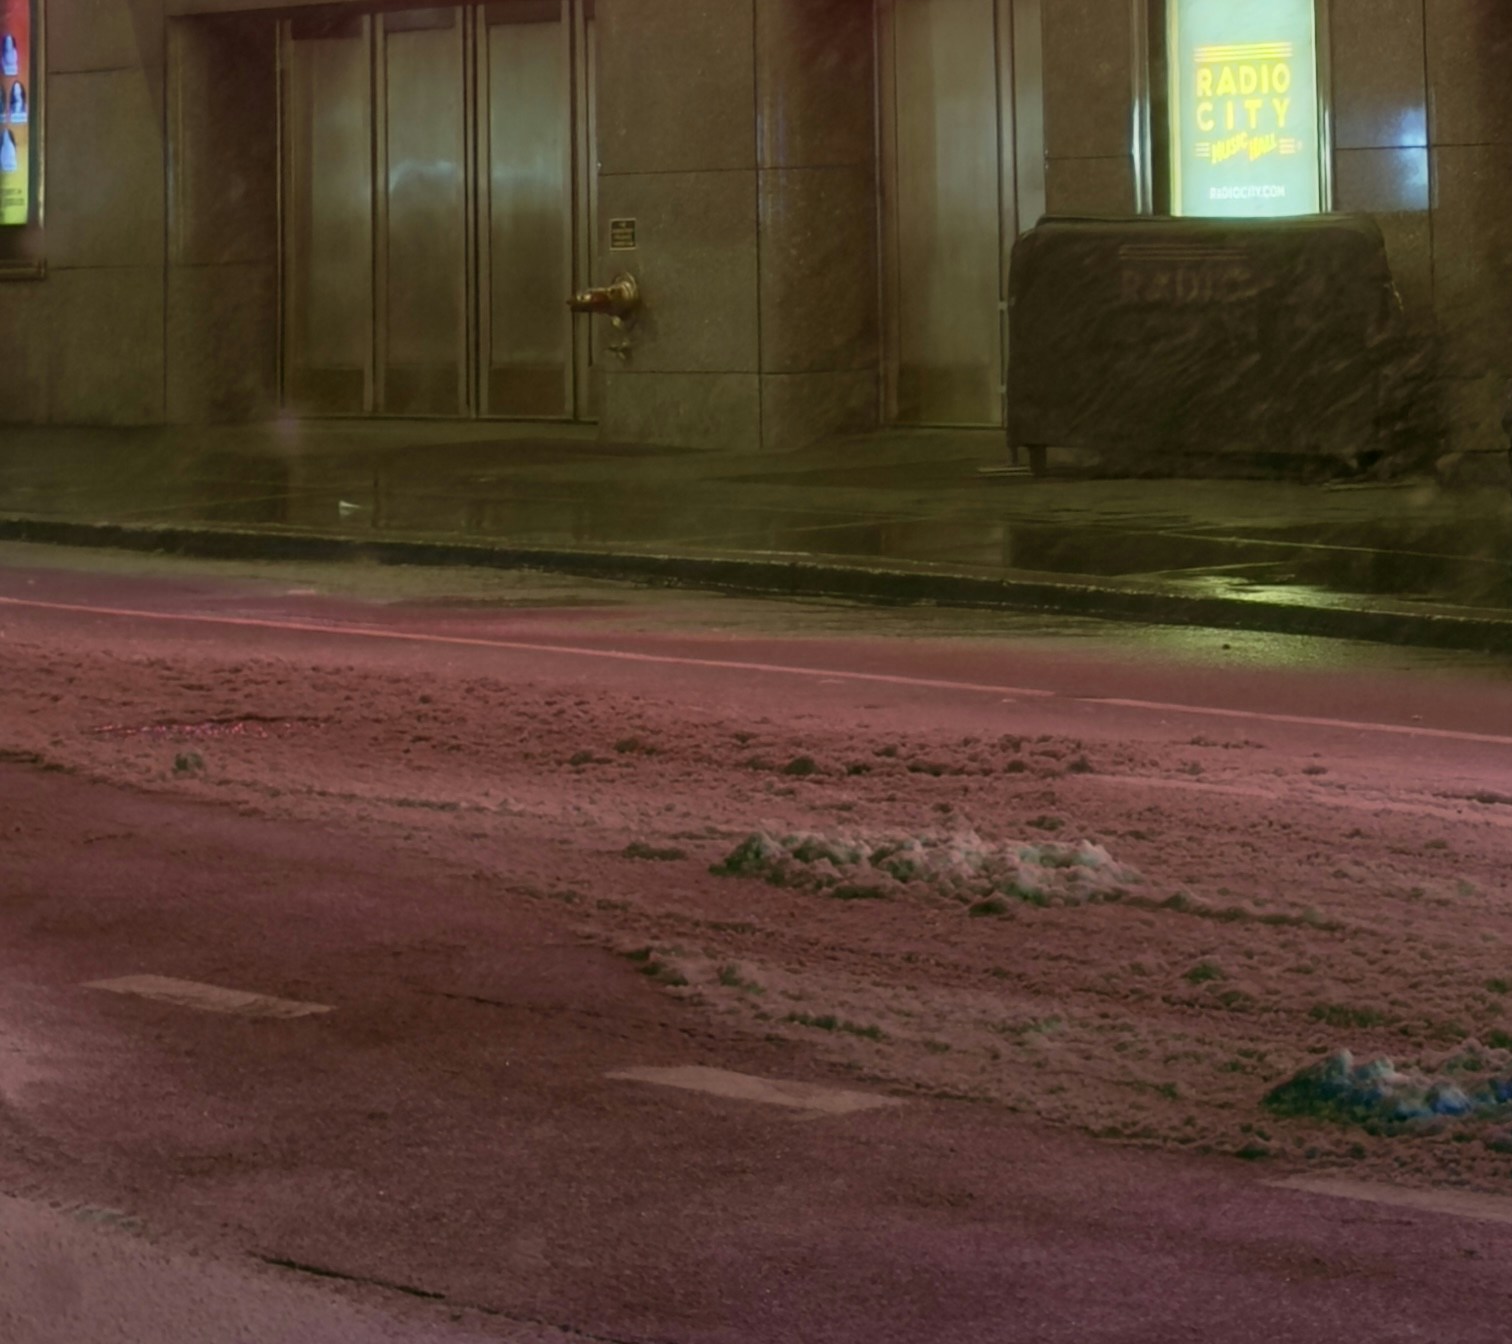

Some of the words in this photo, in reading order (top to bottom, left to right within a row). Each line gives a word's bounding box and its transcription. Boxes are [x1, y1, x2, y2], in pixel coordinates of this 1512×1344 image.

[1195, 62, 1291, 97] RADIO
[1195, 97, 1291, 132] CITY
[1210, 131, 1249, 165] MUSIC
[1248, 132, 1279, 162] HALL
